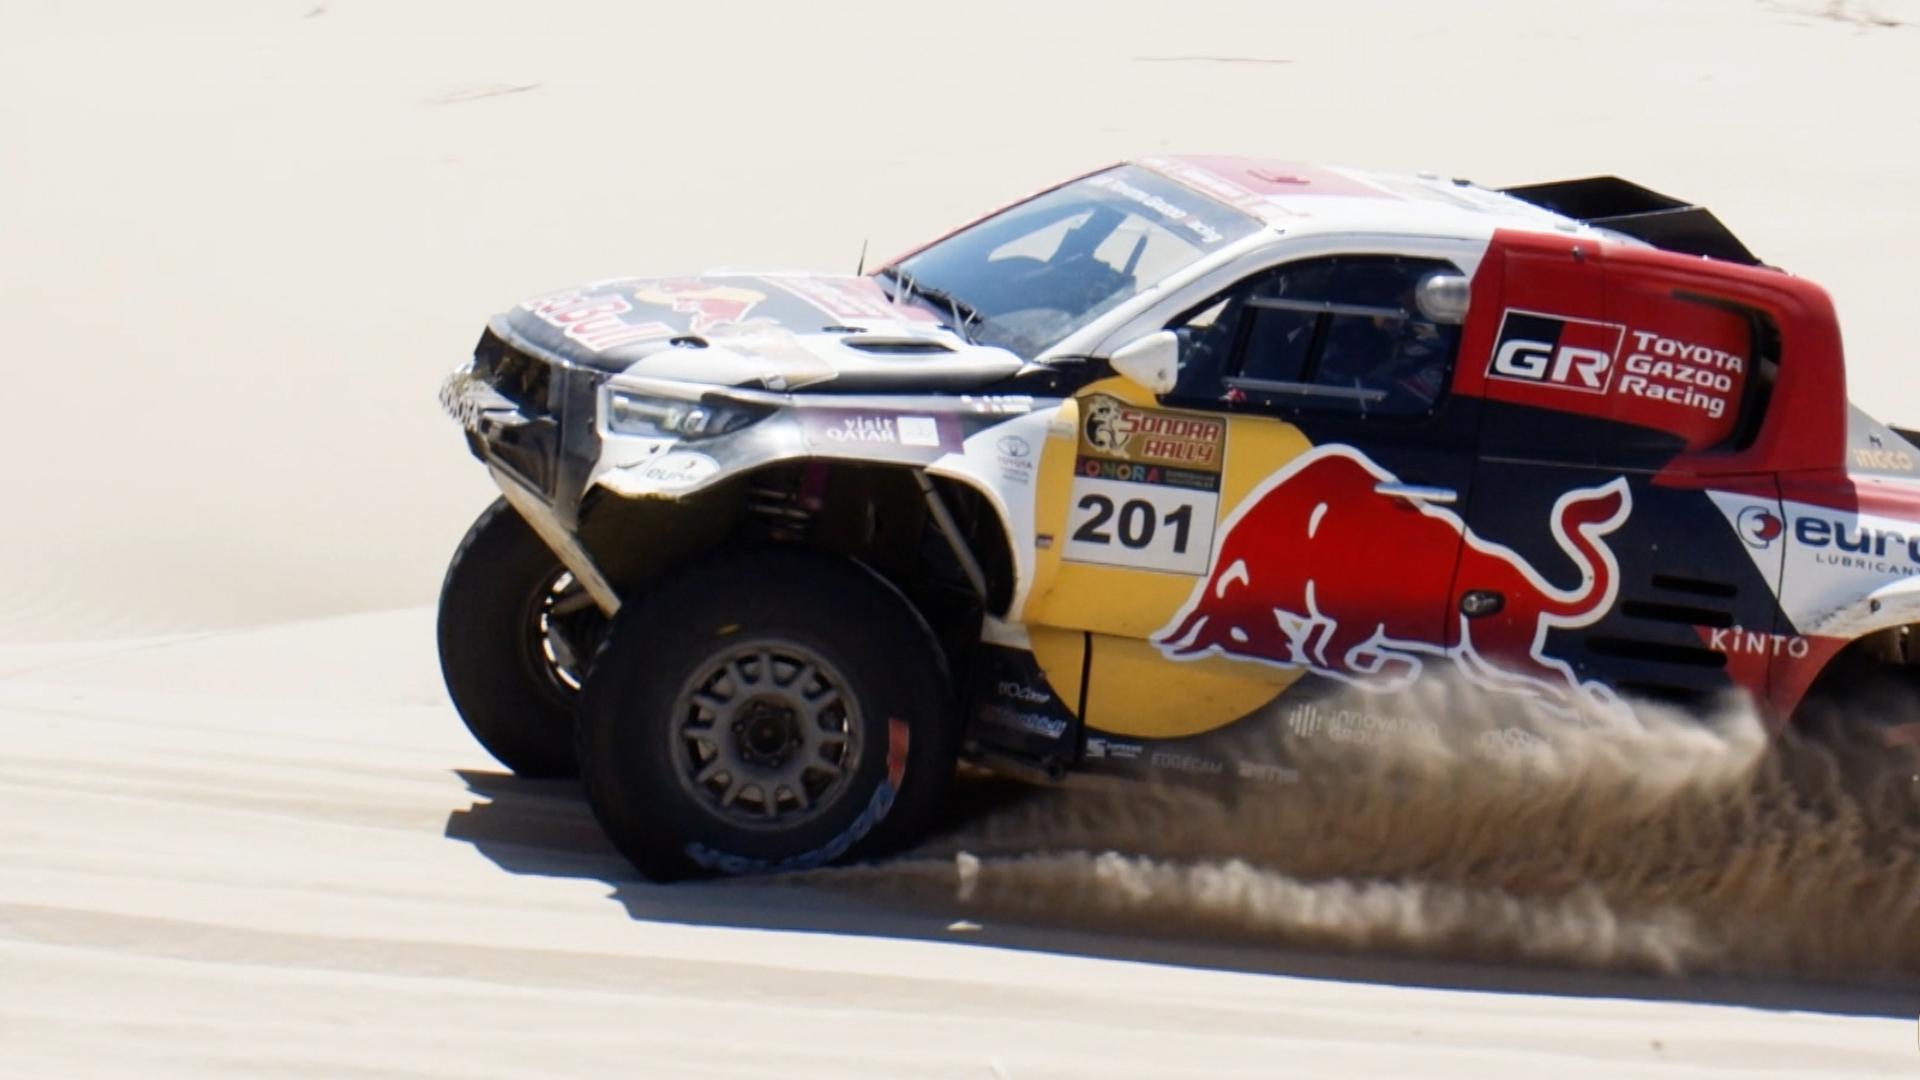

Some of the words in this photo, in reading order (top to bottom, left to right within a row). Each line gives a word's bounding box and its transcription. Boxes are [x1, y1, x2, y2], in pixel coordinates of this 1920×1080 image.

[1494, 338, 1610, 389] GR
[1624, 353, 1732, 393] GAZOO
[1632, 330, 1743, 374] TOYOTA
[1617, 375, 1726, 419] Racing
[1119, 408, 1221, 443] SONORA
[1140, 437, 1216, 465] RALLY
[1071, 492, 1194, 555] 201
